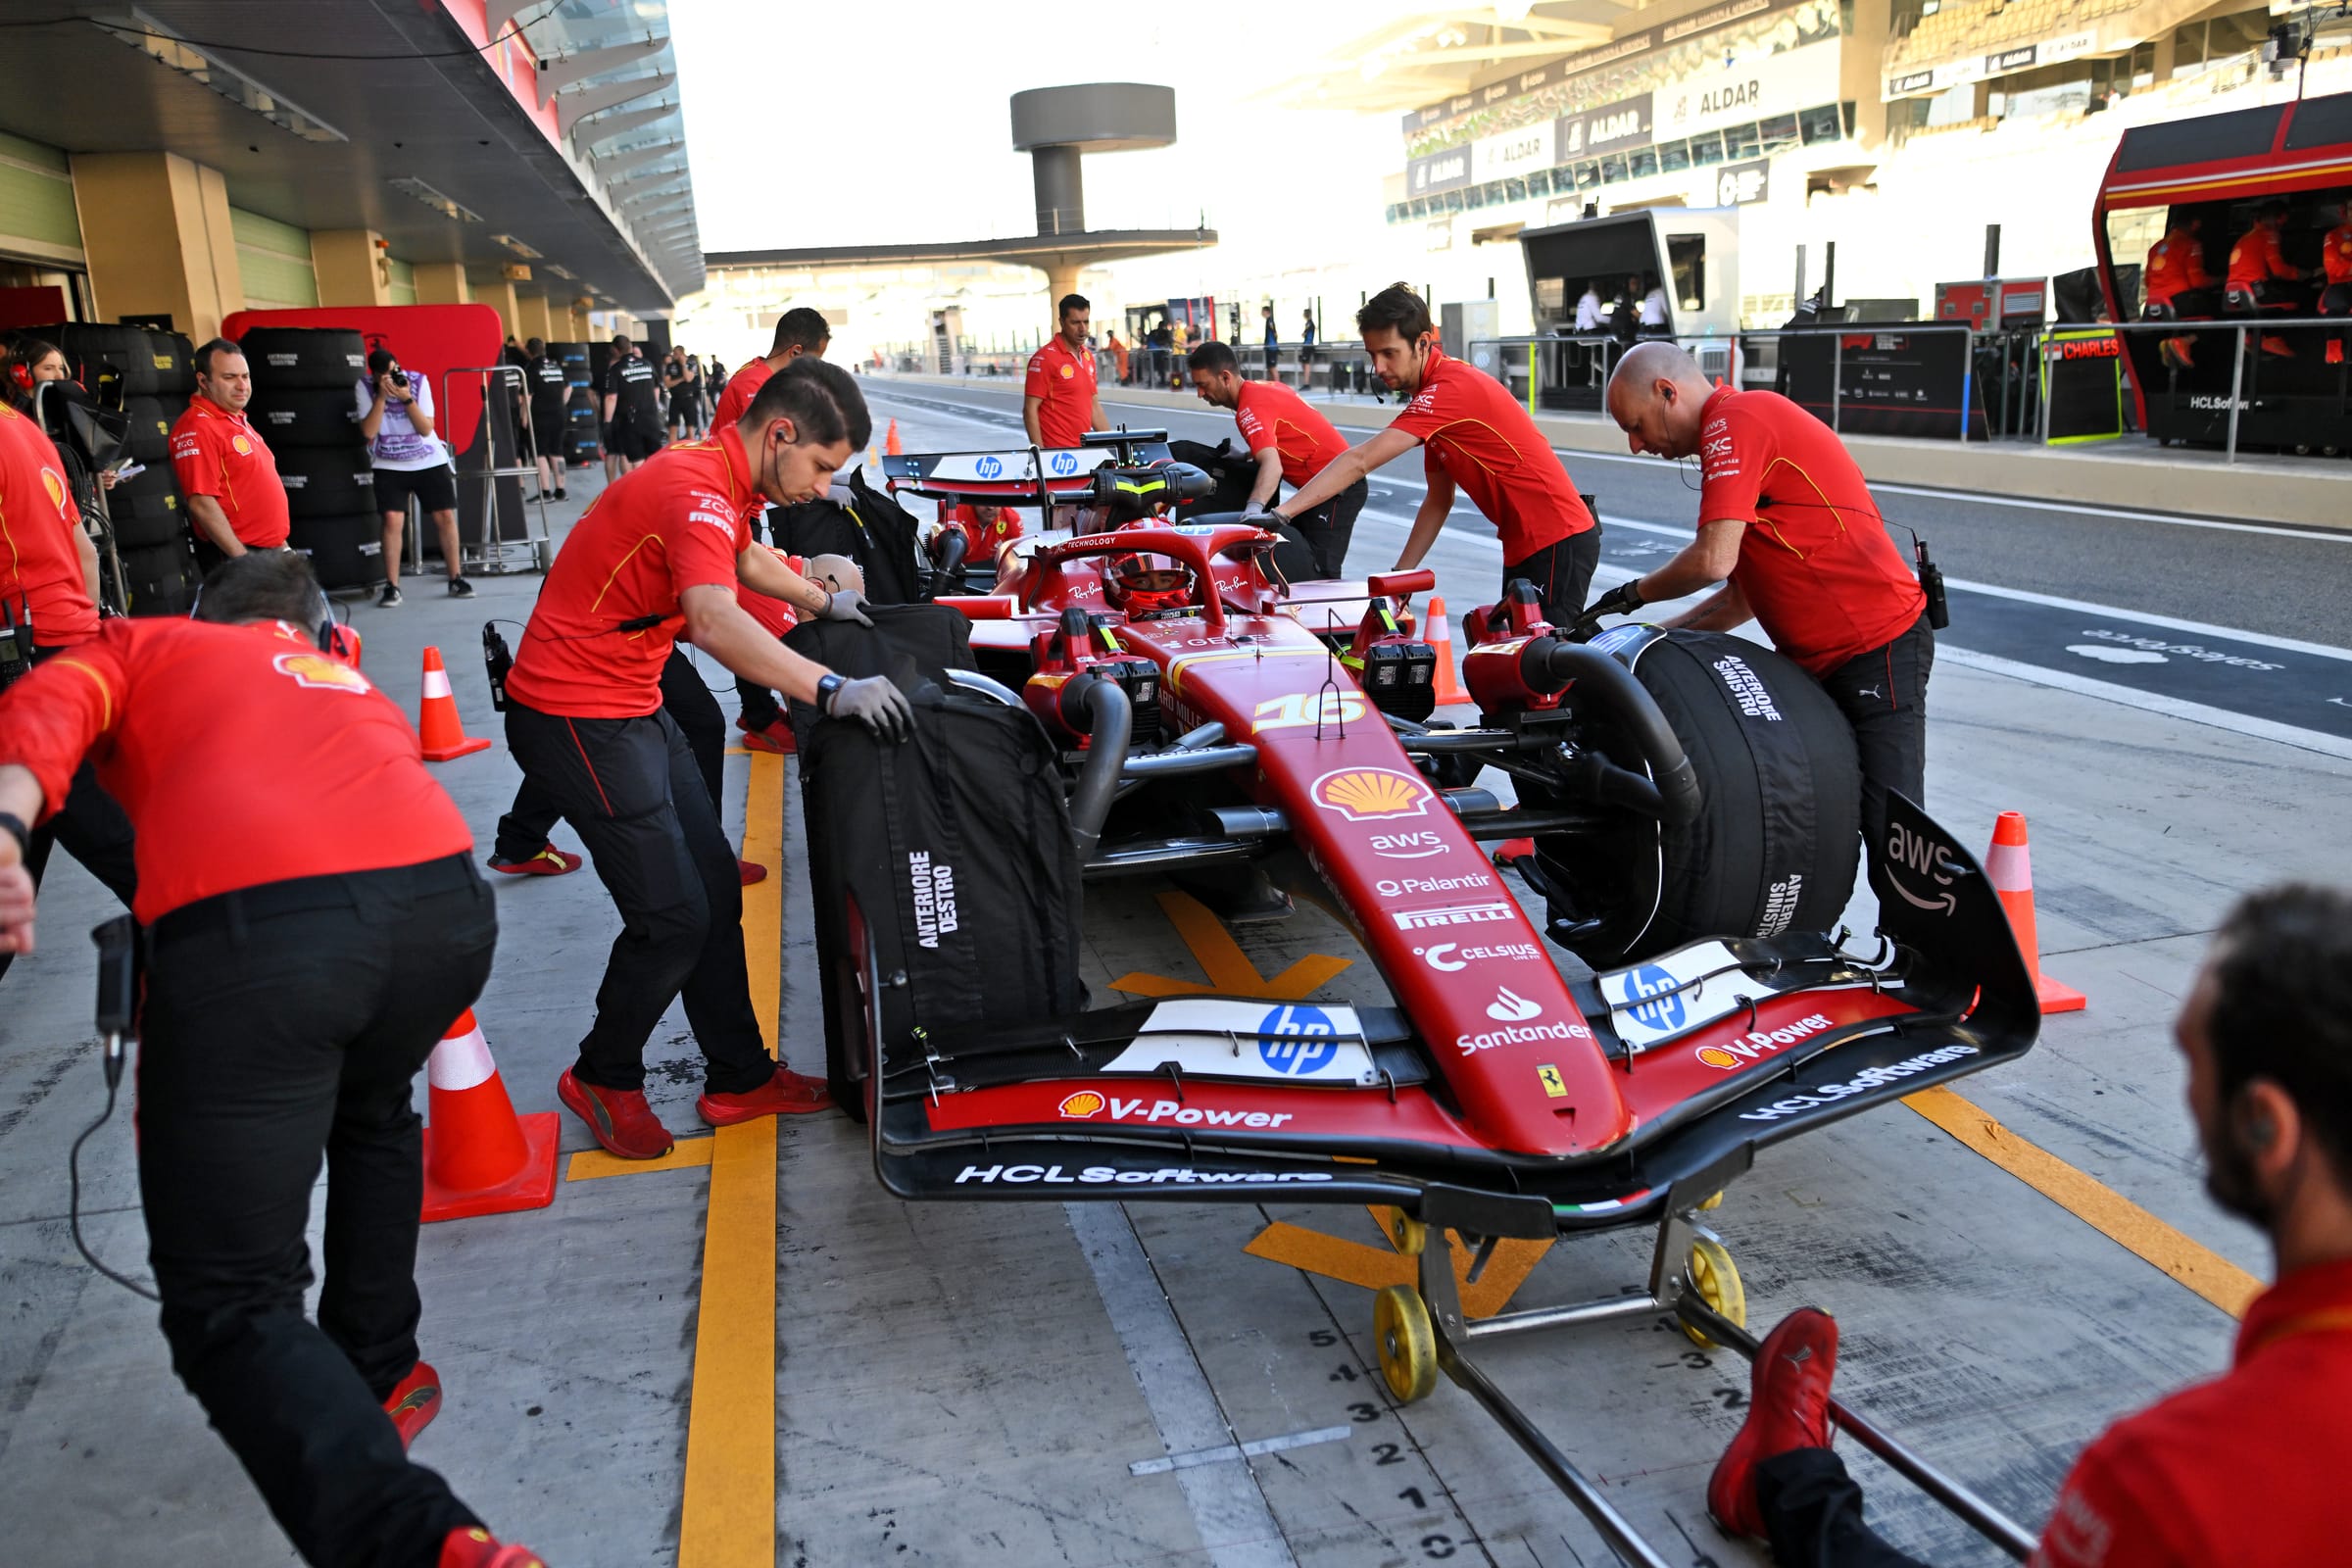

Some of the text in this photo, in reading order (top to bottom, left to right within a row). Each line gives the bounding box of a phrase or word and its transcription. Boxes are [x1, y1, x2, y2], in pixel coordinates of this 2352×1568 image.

[1700, 79, 1760, 114] ALDAR
[1590, 111, 1640, 145] ALDAR
[1504, 138, 1542, 163] ALDAR
[2063, 338, 2120, 360] CHARLES
[979, 457, 1001, 478] hp
[1055, 453, 1075, 475] hp
[1067, 537, 1116, 549] TECHNOLOGY
[1215, 576, 1249, 592] Ray-Ban
[2082, 629, 2286, 670] salesforce
[1713, 660, 1762, 716] SINISTRO
[1724, 655, 1783, 720] ANTERIORE
[1251, 691, 1366, 735] 16
[1369, 831, 1442, 850] aws
[1887, 822, 1953, 885] aws
[1401, 873, 1491, 893] Palantir
[908, 851, 939, 948] ANTERIORE
[932, 865, 958, 933] DESTRO
[1392, 903, 1516, 930] PIRELLI
[1461, 944, 1539, 959] CELSIUS
[1631, 968, 1678, 1031] hp
[1266, 1005, 1331, 1075] hp
[1456, 1021, 1592, 1056] Santander
[1722, 1013, 1835, 1058] V-Power
[1739, 1045, 1980, 1120] HCLSoftware
[1108, 1098, 1293, 1128] V-Power
[955, 1164, 1333, 1184] HCLSoftware
[1309, 1330, 1338, 1348] 5
[1680, 1351, 1713, 1369] 3
[1348, 1402, 1381, 1422] 3
[1713, 1389, 1751, 1409] 2
[1372, 1444, 1406, 1466] 2
[1398, 1488, 1427, 1509] 1
